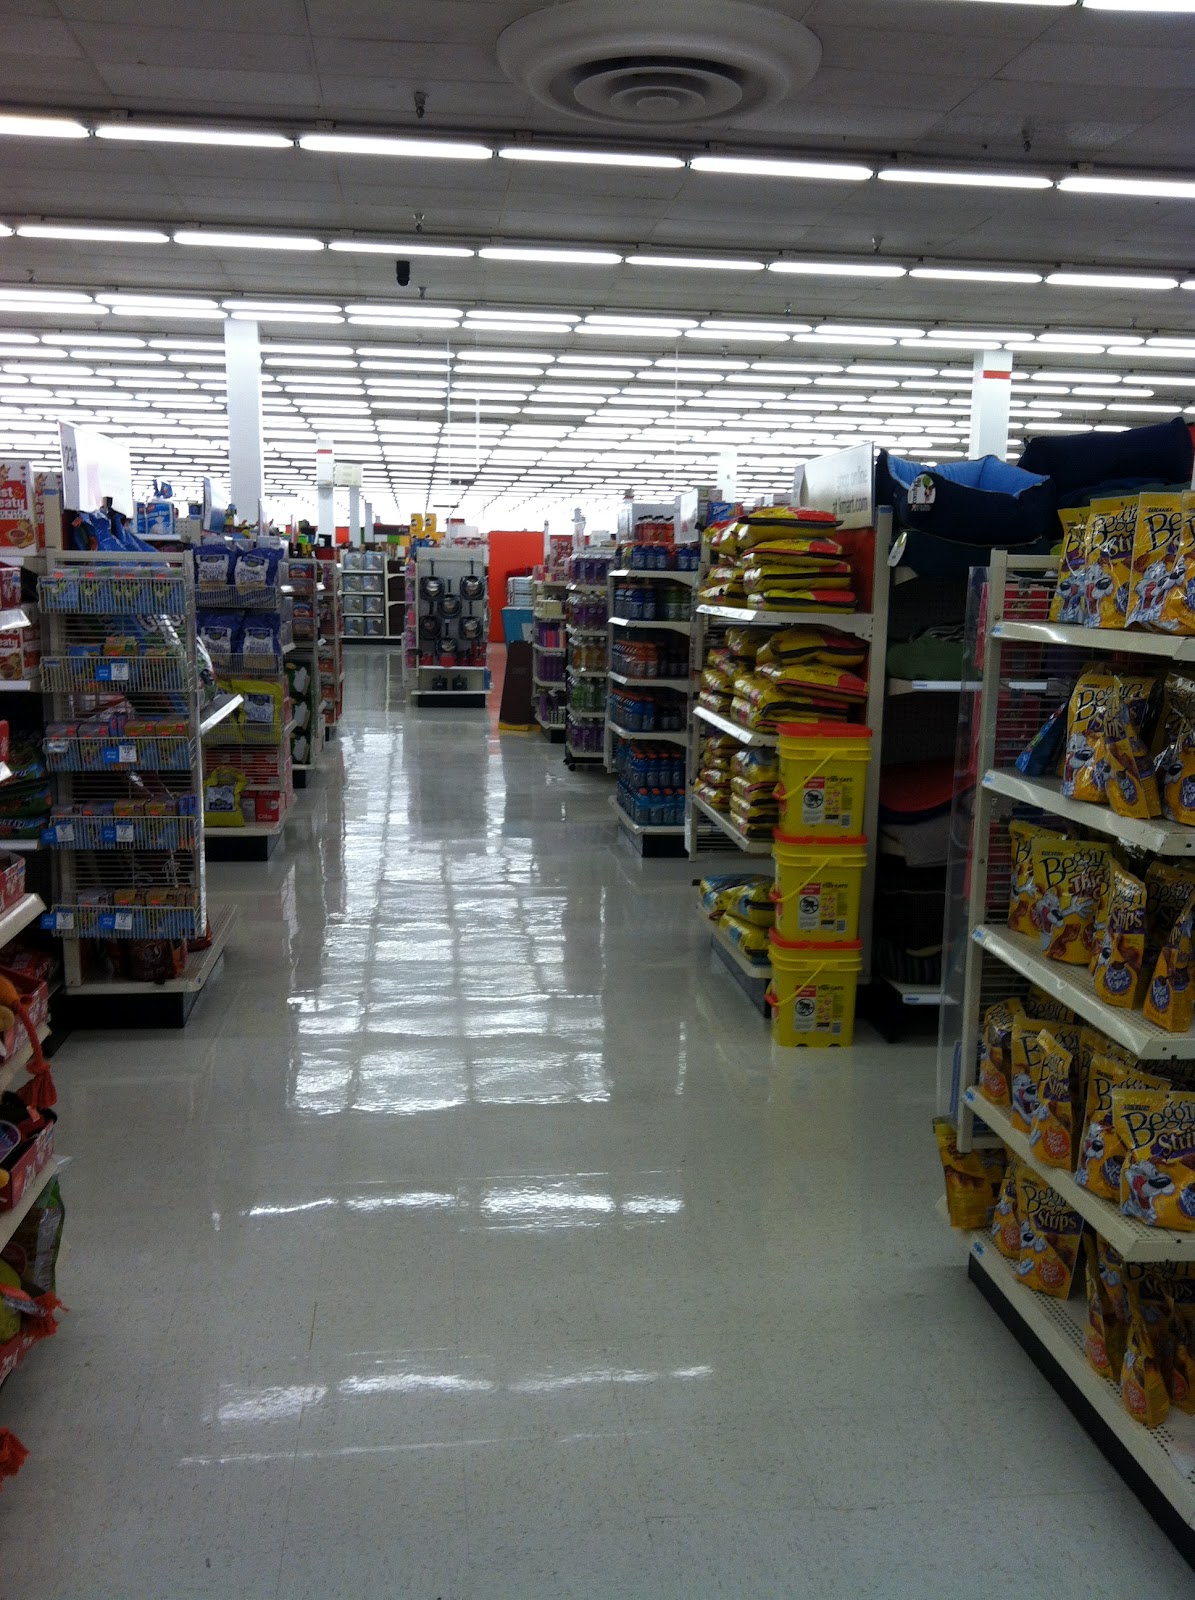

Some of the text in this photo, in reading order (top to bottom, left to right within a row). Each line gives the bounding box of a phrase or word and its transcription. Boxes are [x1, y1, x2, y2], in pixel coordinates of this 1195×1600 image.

[0, 498, 24, 512] eaty
[0, 639, 18, 649] eaty
[1037, 1209, 1077, 1232] Strips
